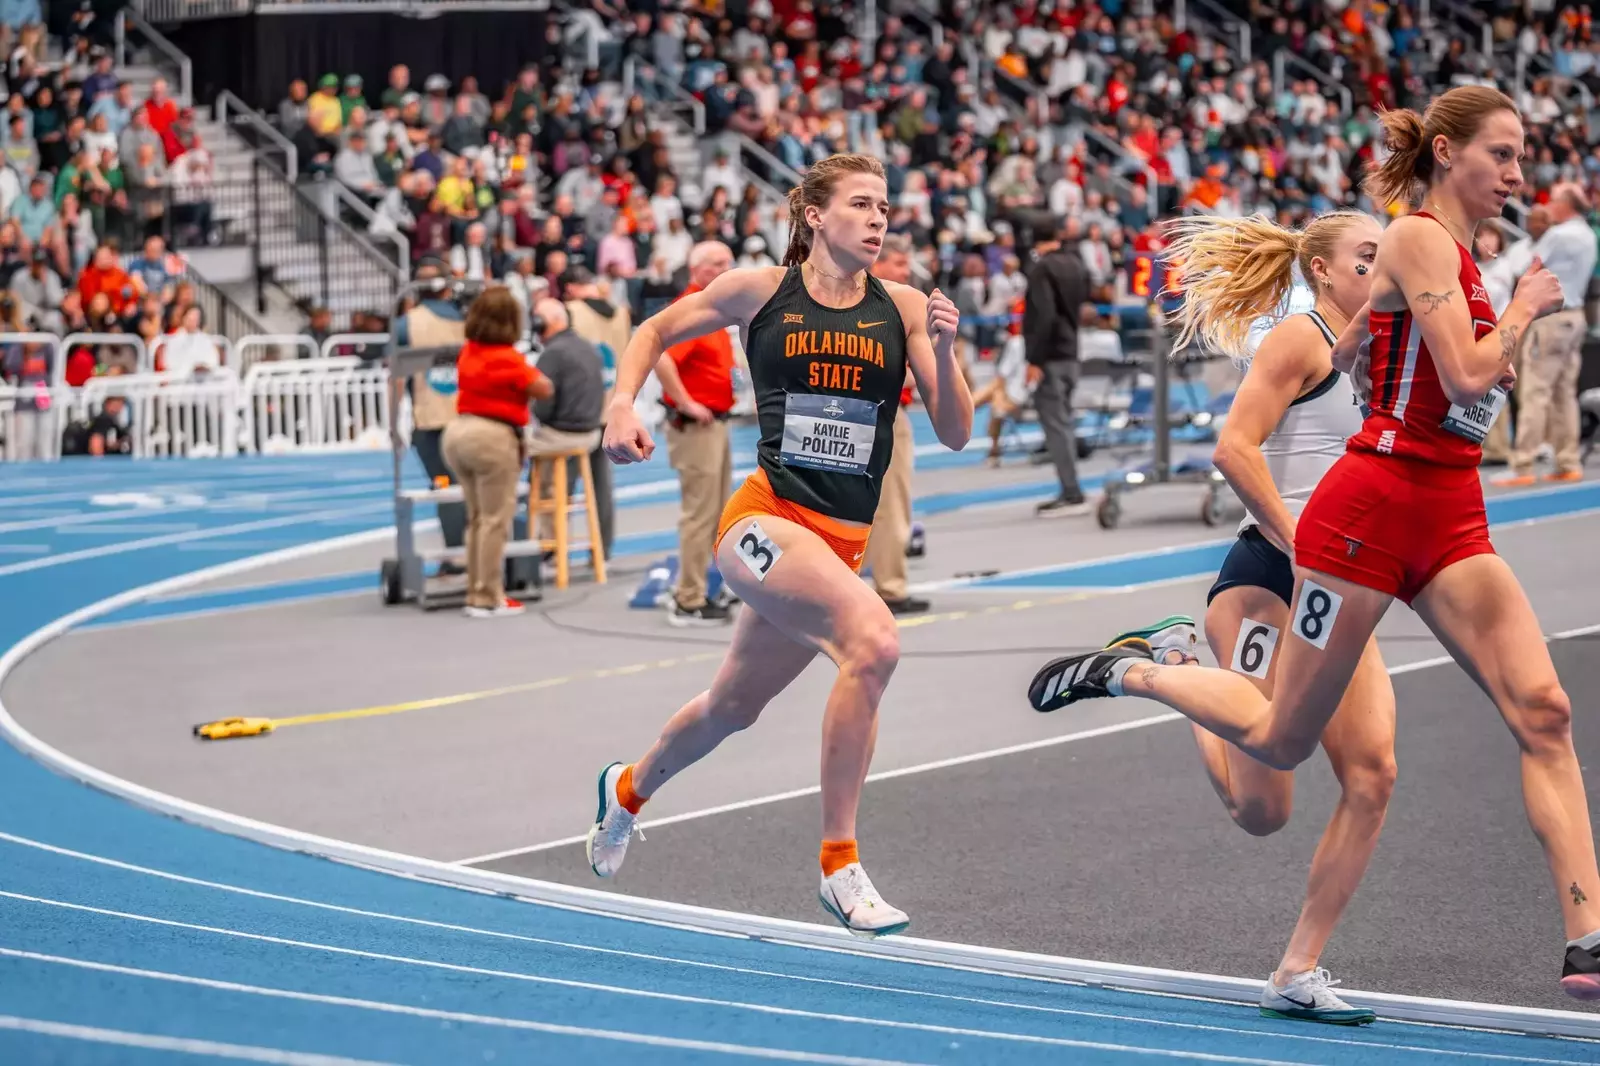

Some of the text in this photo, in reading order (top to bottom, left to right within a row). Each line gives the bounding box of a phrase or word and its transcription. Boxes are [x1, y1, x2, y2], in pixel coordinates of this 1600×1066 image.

[785, 330, 884, 368] OKLAHOMA
[809, 362, 863, 391] STATE
[801, 436, 855, 458] POLITZA
[813, 422, 850, 439] KAYLIE
[740, 533, 773, 574] 3
[1301, 589, 1331, 640] 8
[1240, 626, 1269, 672] 6
